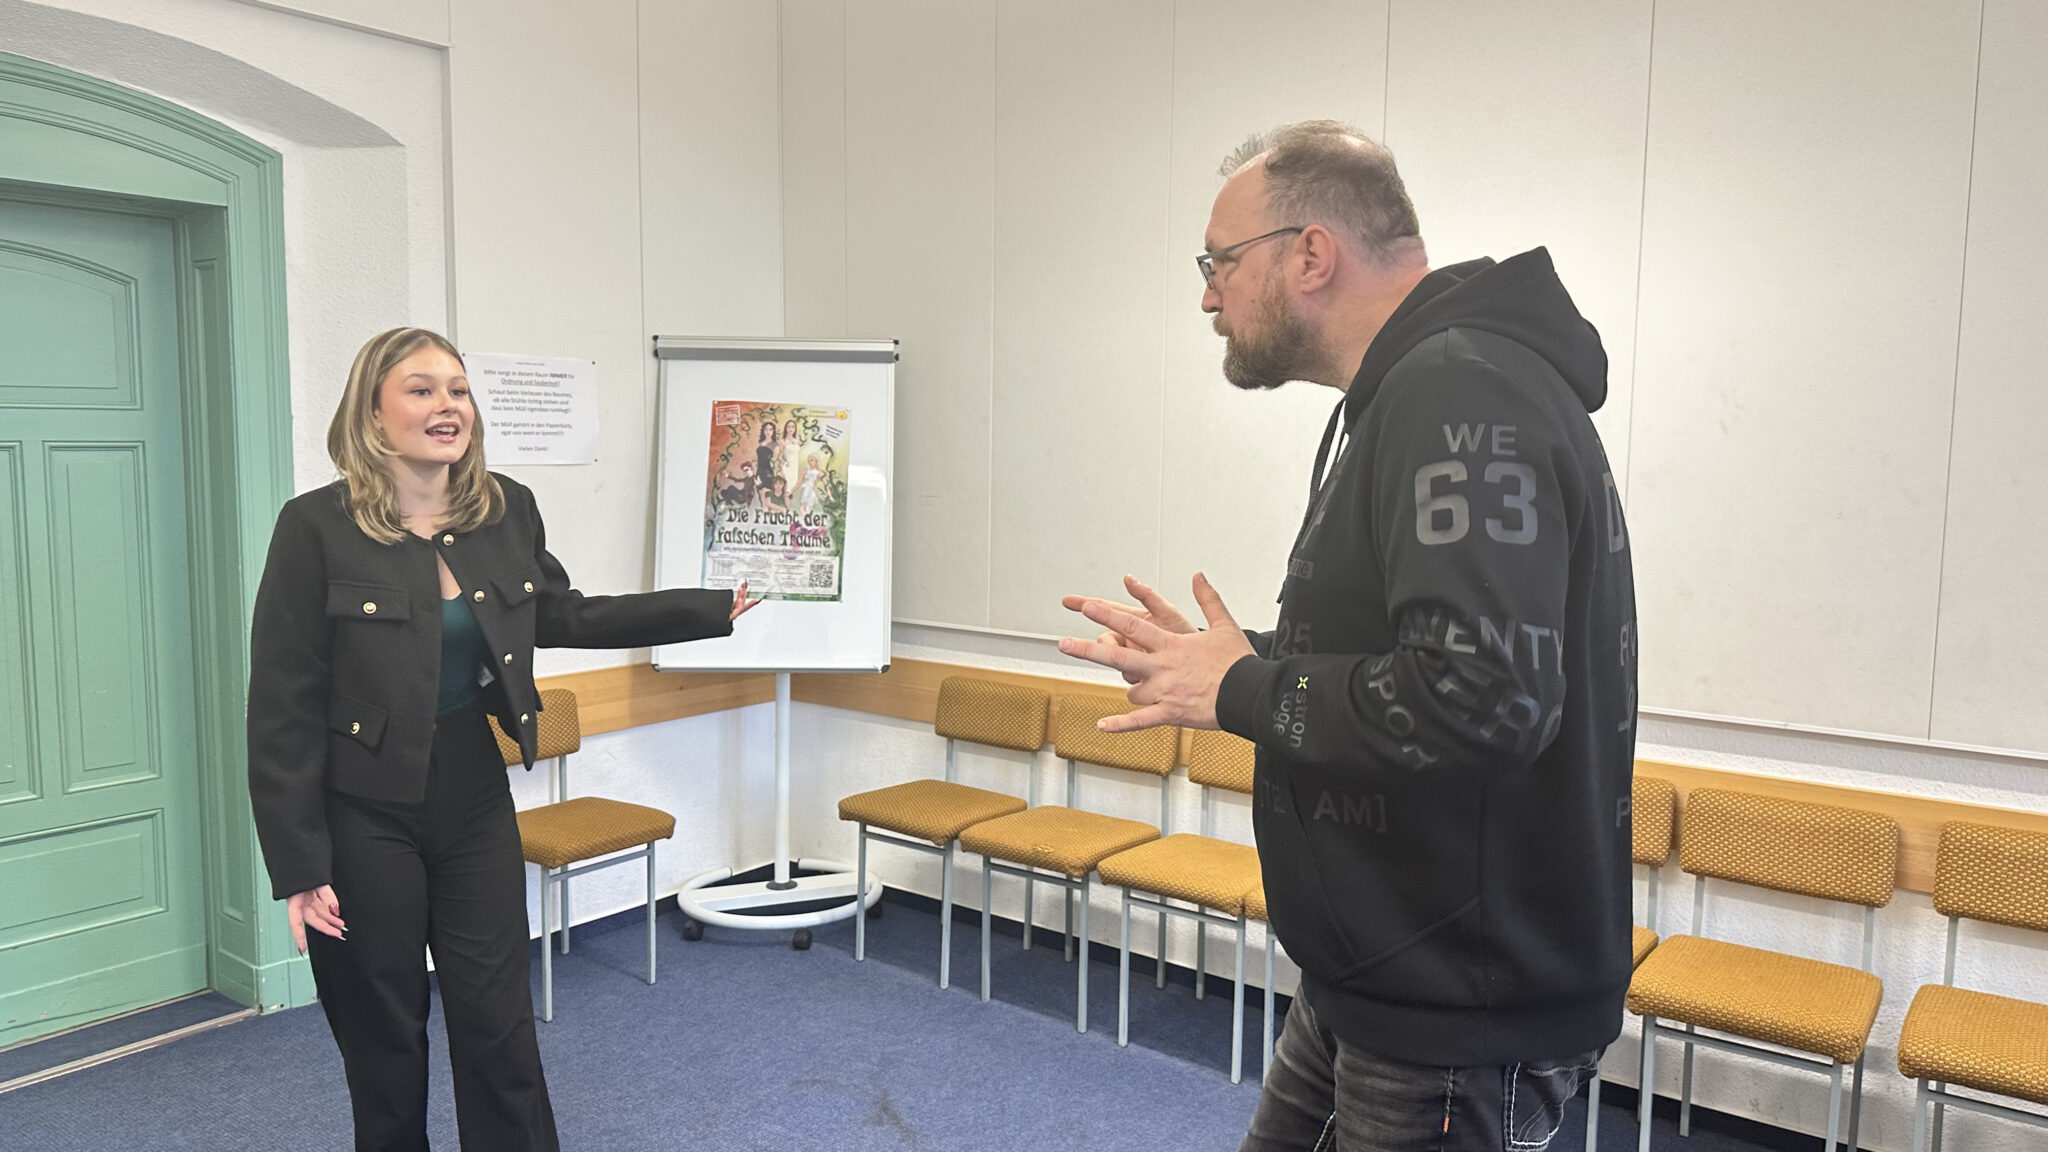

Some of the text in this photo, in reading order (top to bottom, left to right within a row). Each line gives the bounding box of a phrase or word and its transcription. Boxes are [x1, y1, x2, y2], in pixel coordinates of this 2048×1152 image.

[1442, 422, 1517, 455] WE
[1414, 459, 1538, 546] 63
[725, 508, 828, 527] Die Frucht der
[714, 526, 775, 545] falschen
